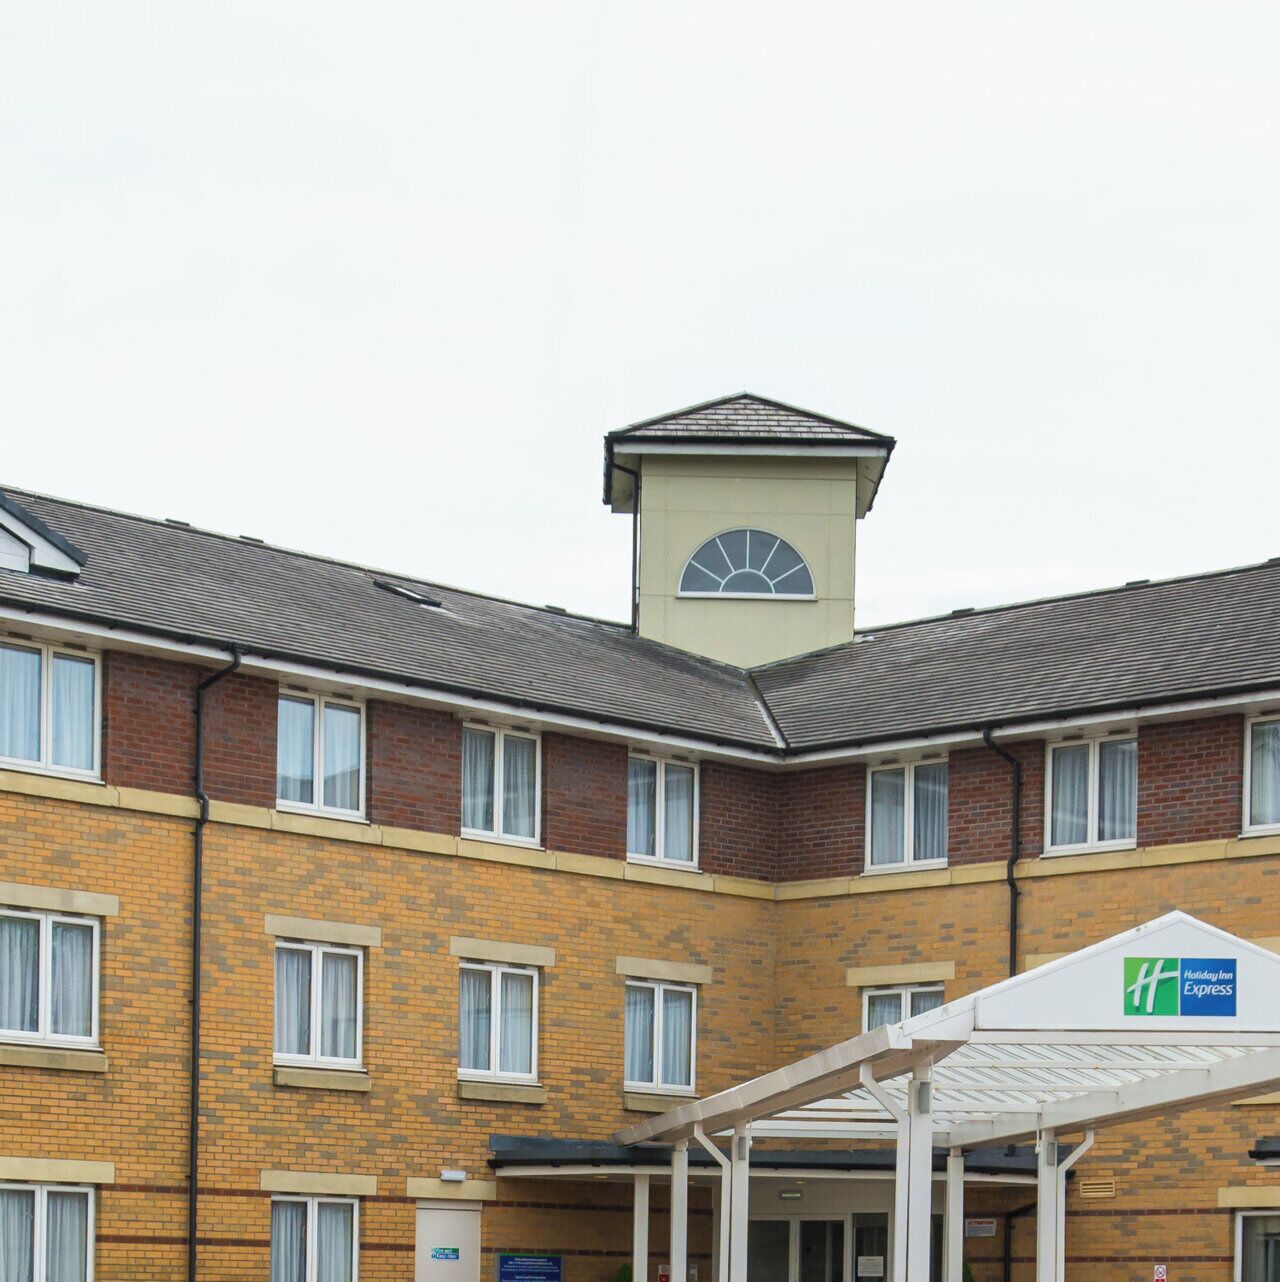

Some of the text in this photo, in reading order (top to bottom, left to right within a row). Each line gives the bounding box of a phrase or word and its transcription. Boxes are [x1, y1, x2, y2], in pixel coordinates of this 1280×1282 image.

[1184, 969, 1233, 982] Holiday Inn
[1184, 981, 1233, 998] Express
